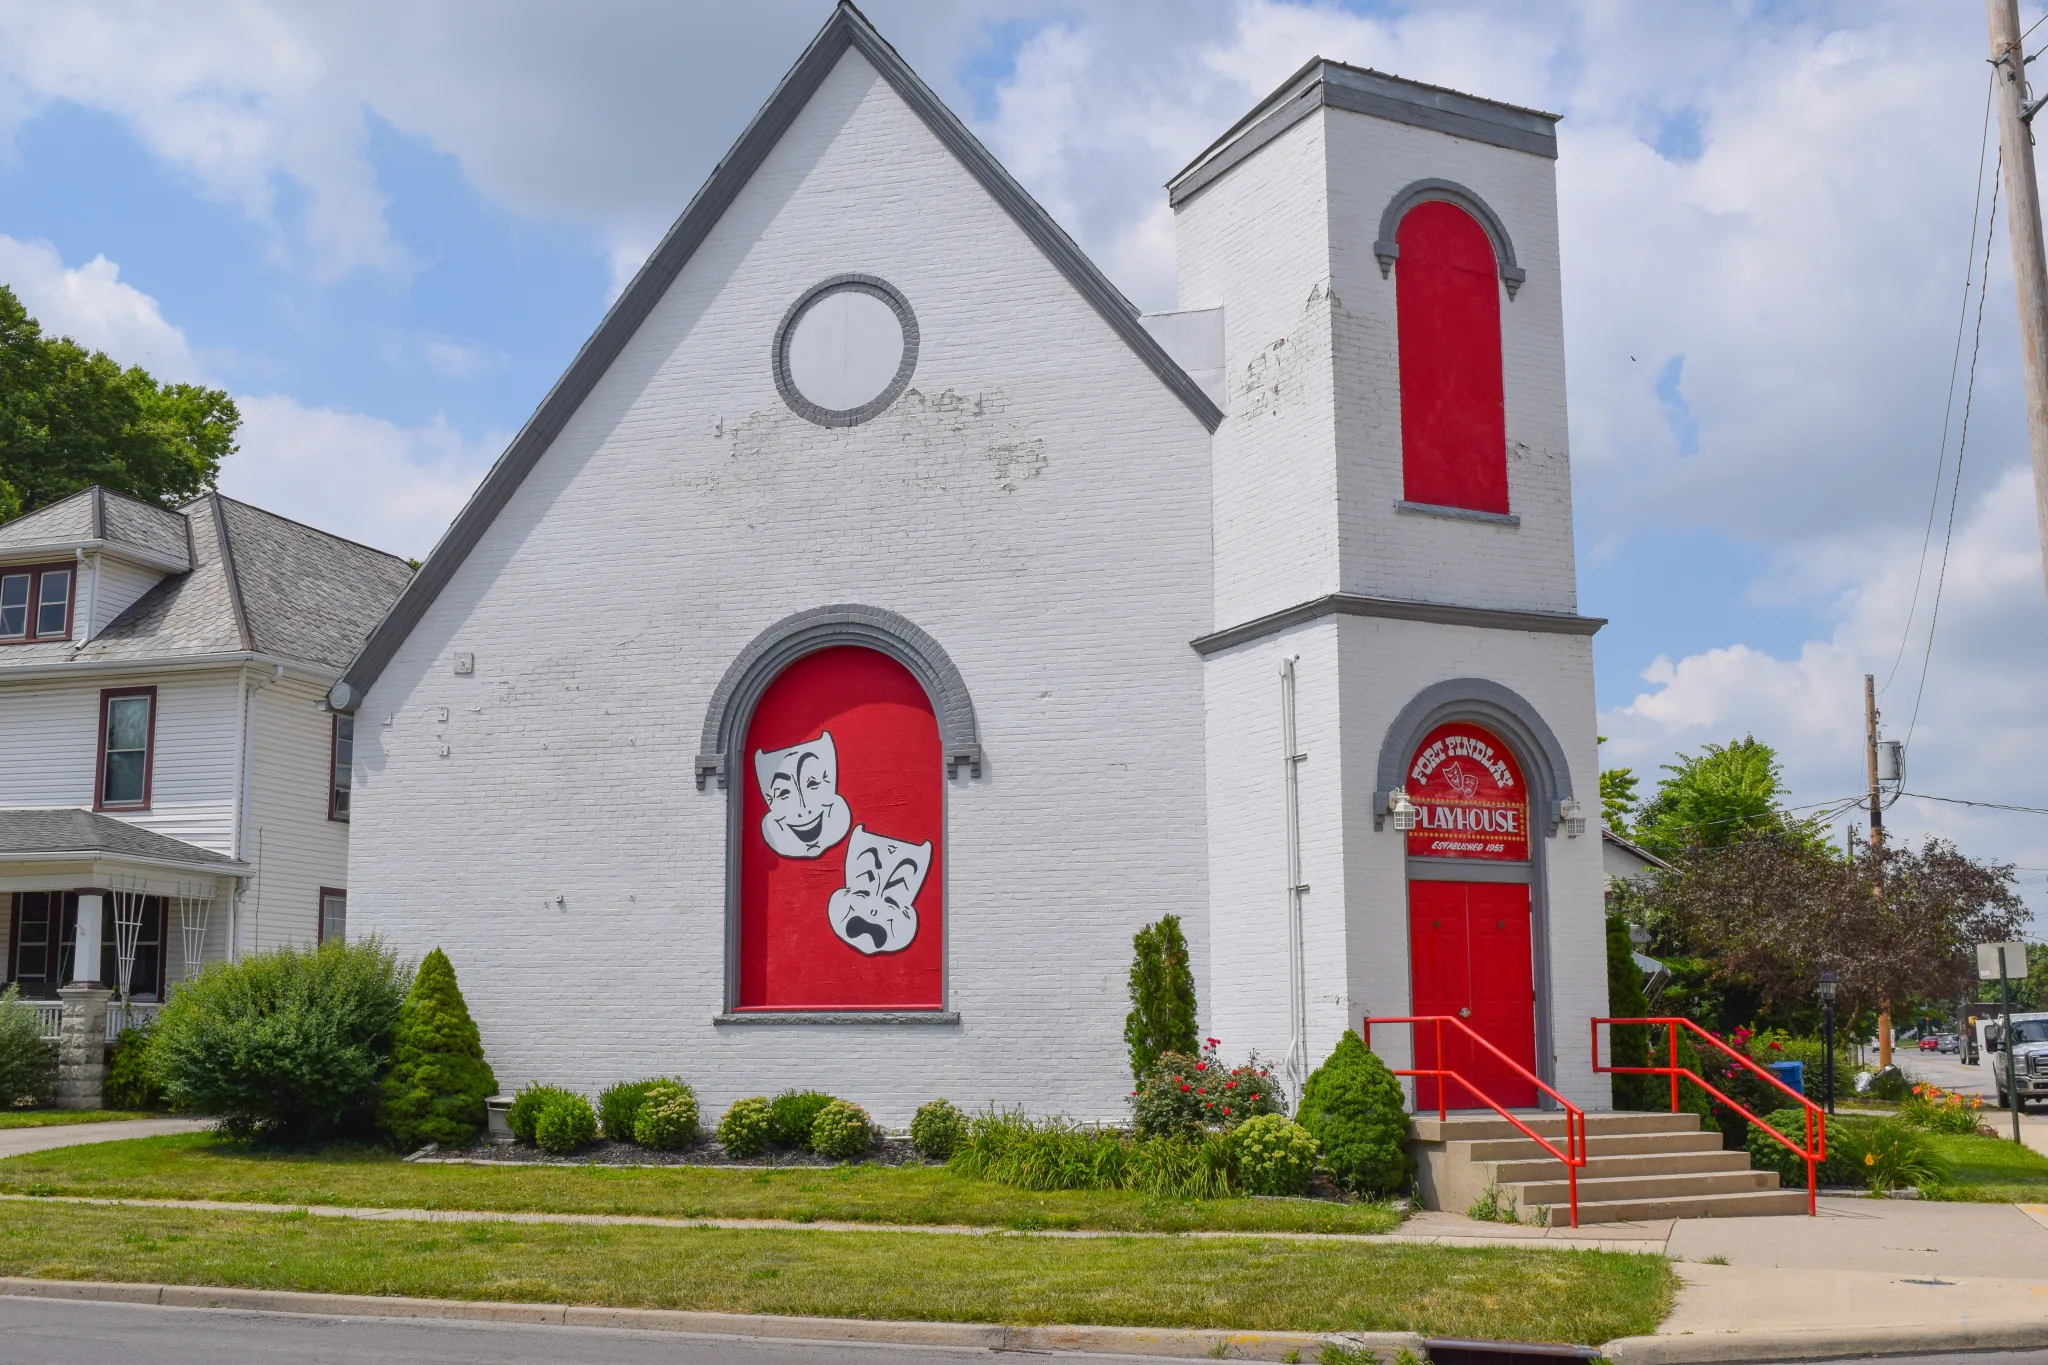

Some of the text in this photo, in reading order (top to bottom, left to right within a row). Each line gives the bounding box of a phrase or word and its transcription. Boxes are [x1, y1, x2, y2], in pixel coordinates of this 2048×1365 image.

[1412, 736, 1514, 788] FORT FINDLAY
[1412, 806, 1518, 832] PLAYHOUSE
[1431, 841, 1505, 852] ESTABLISHED 1955
